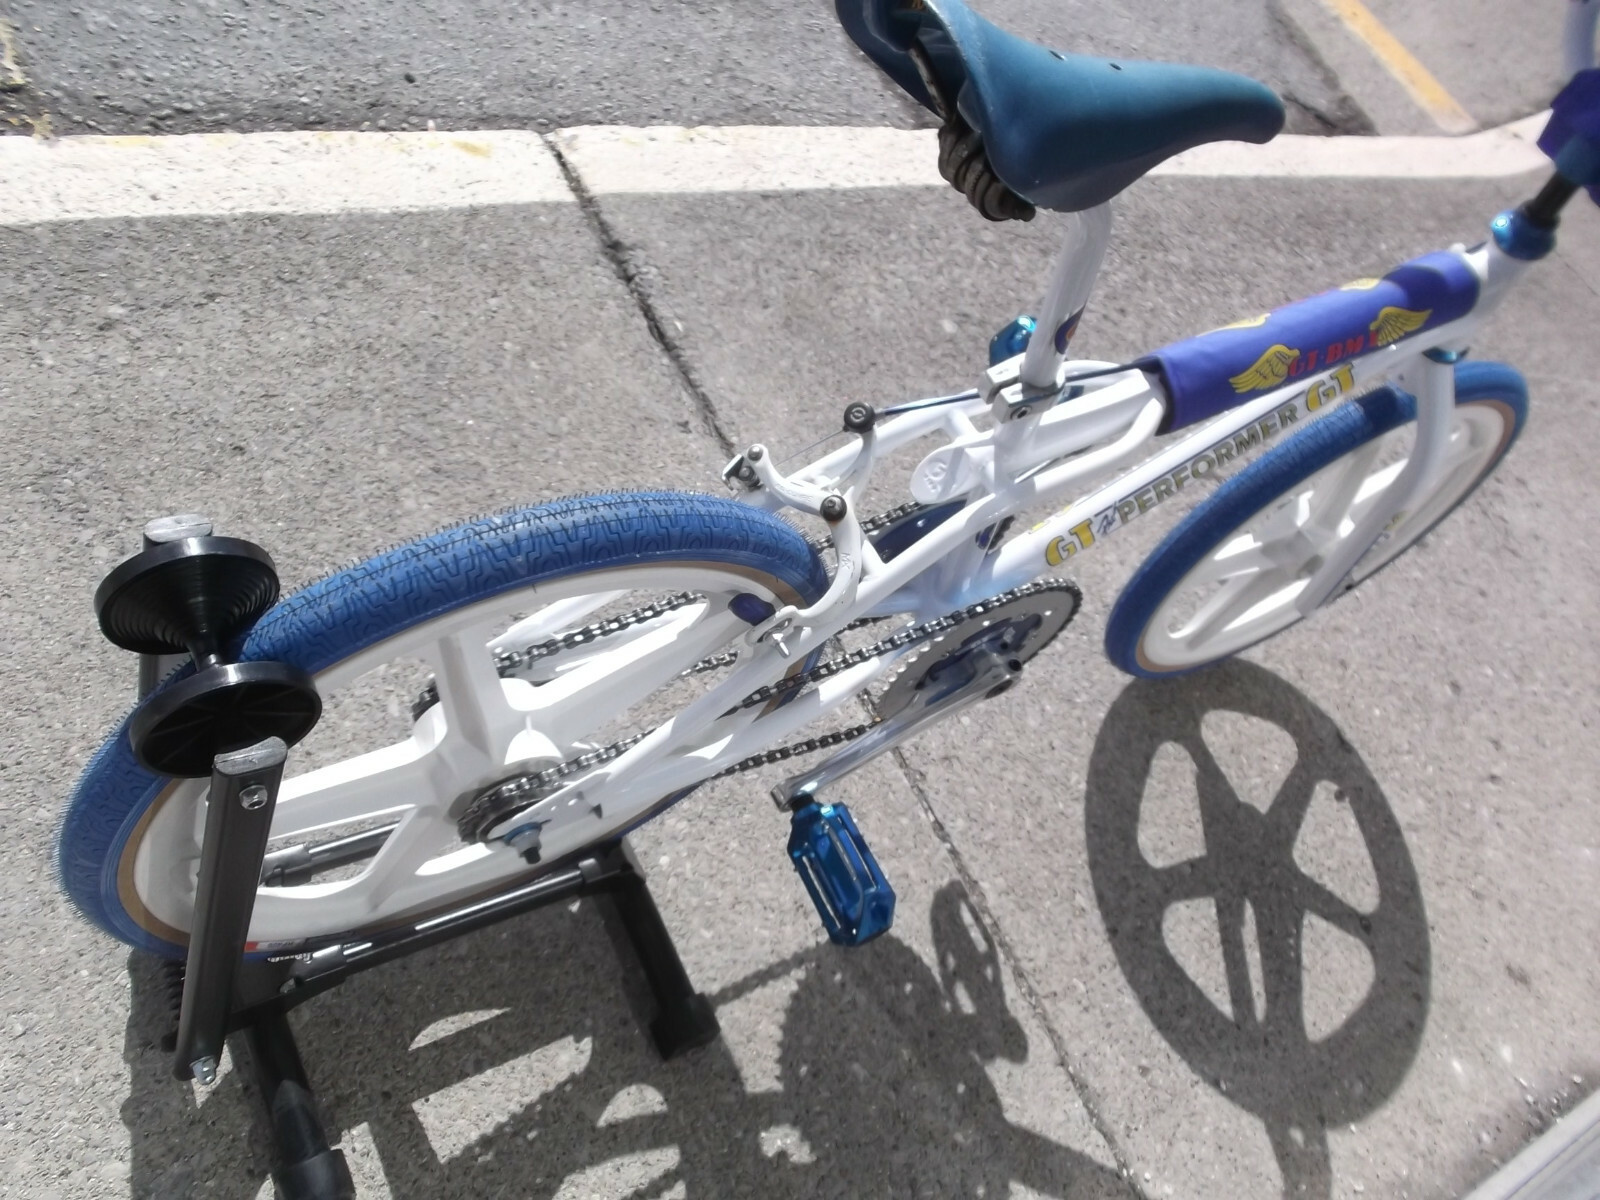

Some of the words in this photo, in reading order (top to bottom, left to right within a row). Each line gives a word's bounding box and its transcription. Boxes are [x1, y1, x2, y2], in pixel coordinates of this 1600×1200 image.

[1045, 517, 1096, 567] GT
[1117, 402, 1299, 525] PERFORMER
[1305, 363, 1355, 412] GT
